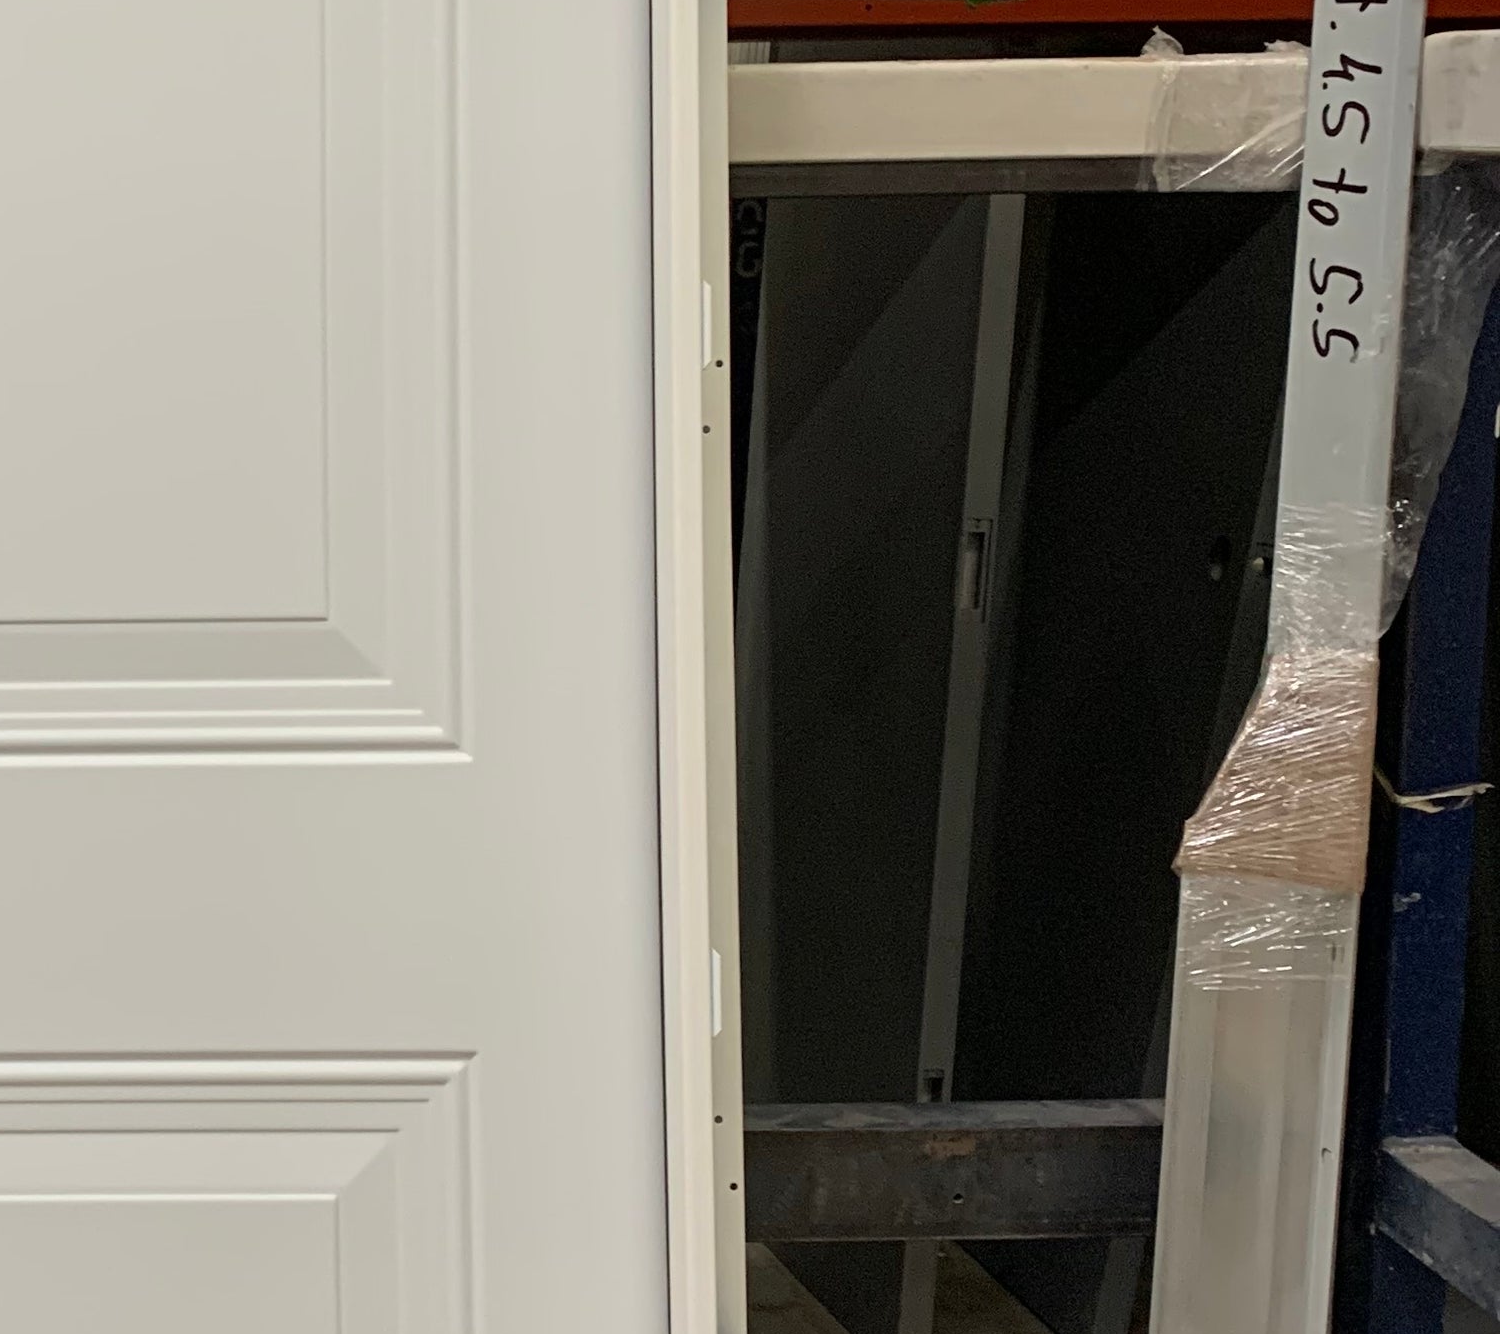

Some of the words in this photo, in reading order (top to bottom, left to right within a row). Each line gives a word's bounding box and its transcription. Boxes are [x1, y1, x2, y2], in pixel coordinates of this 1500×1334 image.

[1322, 53, 1382, 144] 4.5
[1308, 168, 1368, 227] to
[1310, 258, 1364, 364] 5.5
